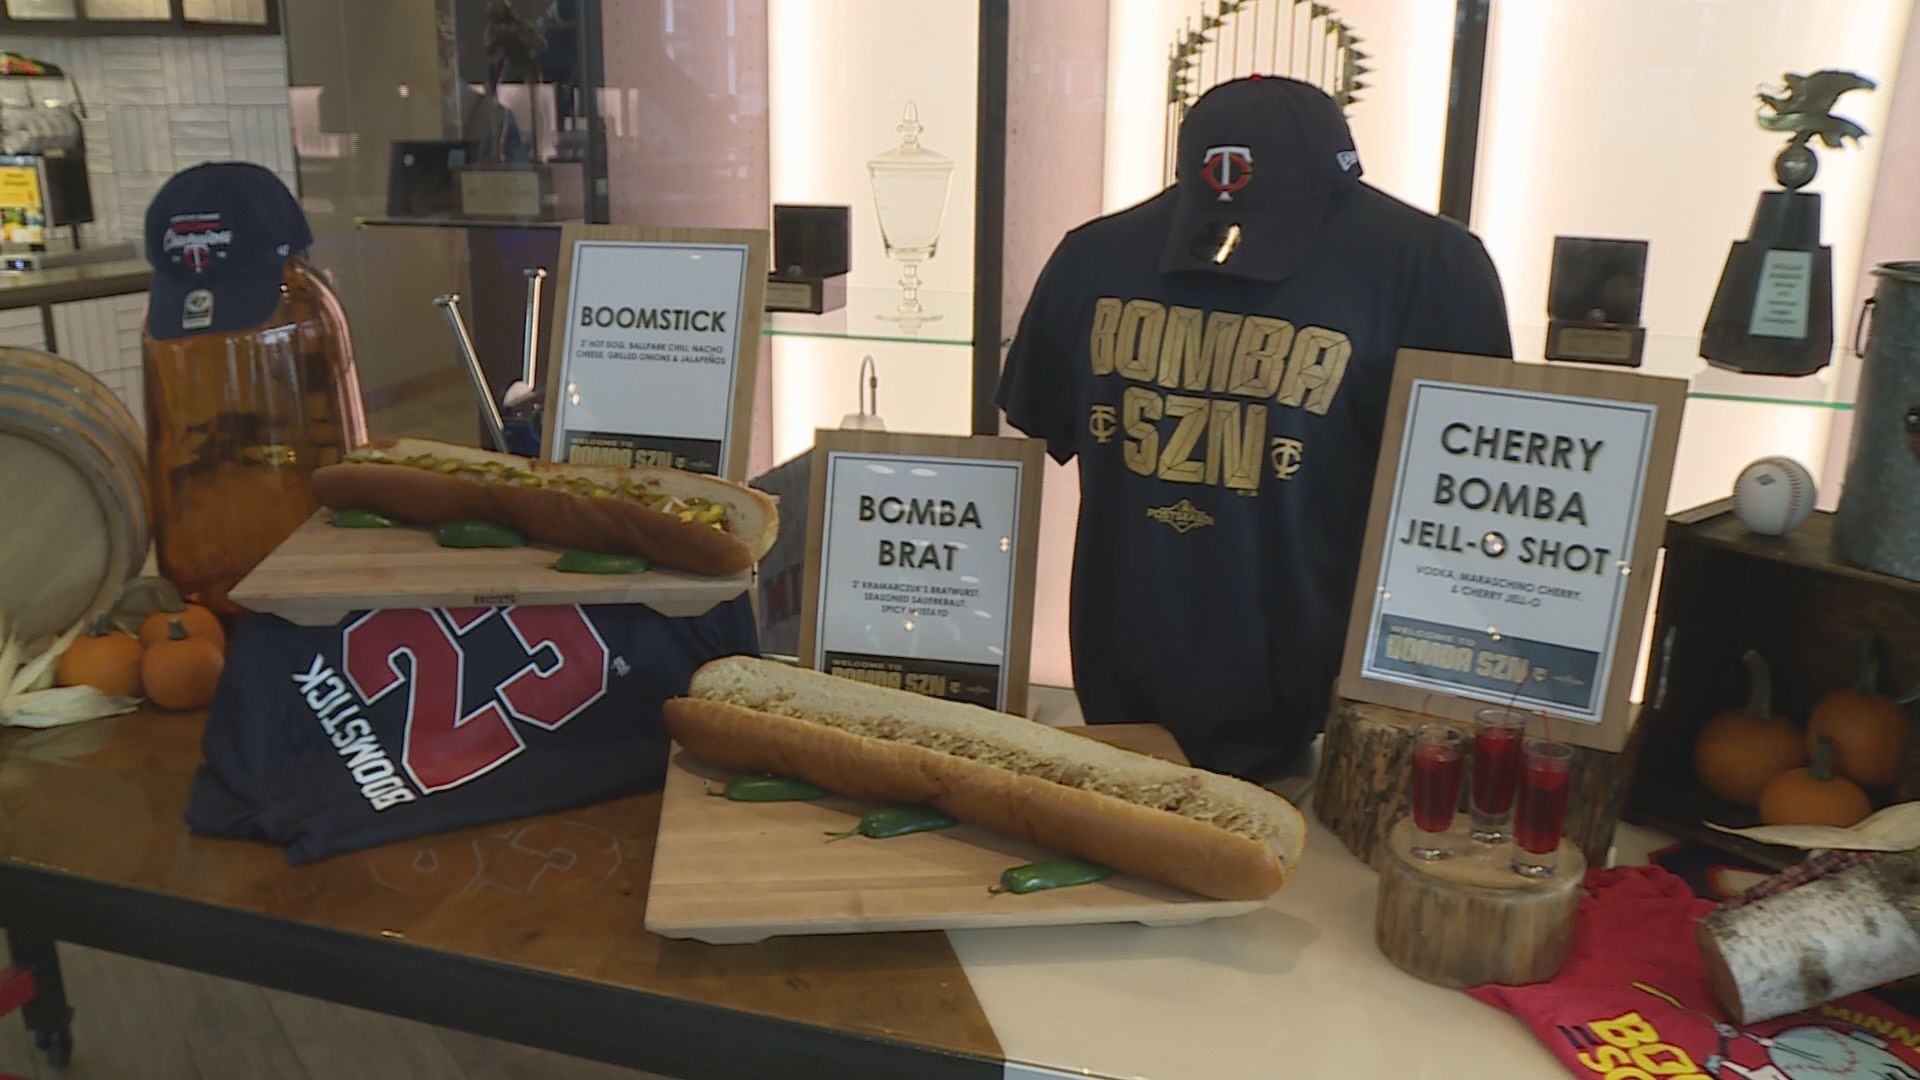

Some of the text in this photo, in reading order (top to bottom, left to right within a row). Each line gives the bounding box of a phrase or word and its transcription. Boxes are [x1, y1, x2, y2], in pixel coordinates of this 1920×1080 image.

[580, 306, 727, 333] BOOMSTICK
[589, 340, 604, 348] HOT
[629, 341, 666, 351] BALLPARK
[692, 344, 723, 354] NACHO
[607, 351, 637, 360] GRILLED
[639, 352, 670, 362] ONIONS
[673, 354, 679, 362] &
[680, 353, 727, 365] JALAPEÑOS
[1090, 296, 1352, 416] BOMBA
[570, 437, 634, 448] WELCOME TO
[1122, 386, 1268, 491] SZN
[1440, 421, 1604, 471] CHERRY
[858, 494, 983, 529] BOMBA
[1433, 472, 1588, 526] BOMBA
[878, 540, 959, 571] BRAT
[1400, 519, 1611, 575] JELL-O SHOT
[862, 581, 928, 594] KRAMARCZUK'S
[930, 584, 981, 598] BRATWURST,
[1416, 565, 1584, 602] VODKA, MARASCHINO CHERRY,
[1450, 585, 1542, 609] & CHERRY JELL-O
[864, 591, 967, 608] SEASONED SAUERKRAUT,
[881, 604, 906, 615] SPICY
[1389, 624, 1477, 648] WELCOME TO
[832, 658, 903, 671] WELCOME TO
[1385, 634, 1530, 684] BOMBA SZN
[905, 672, 947, 696] SZN
[292, 653, 416, 812] BOOMSTICK
[1821, 1003, 1920, 1056] MINN
[1587, 1012, 1716, 1080] BO
